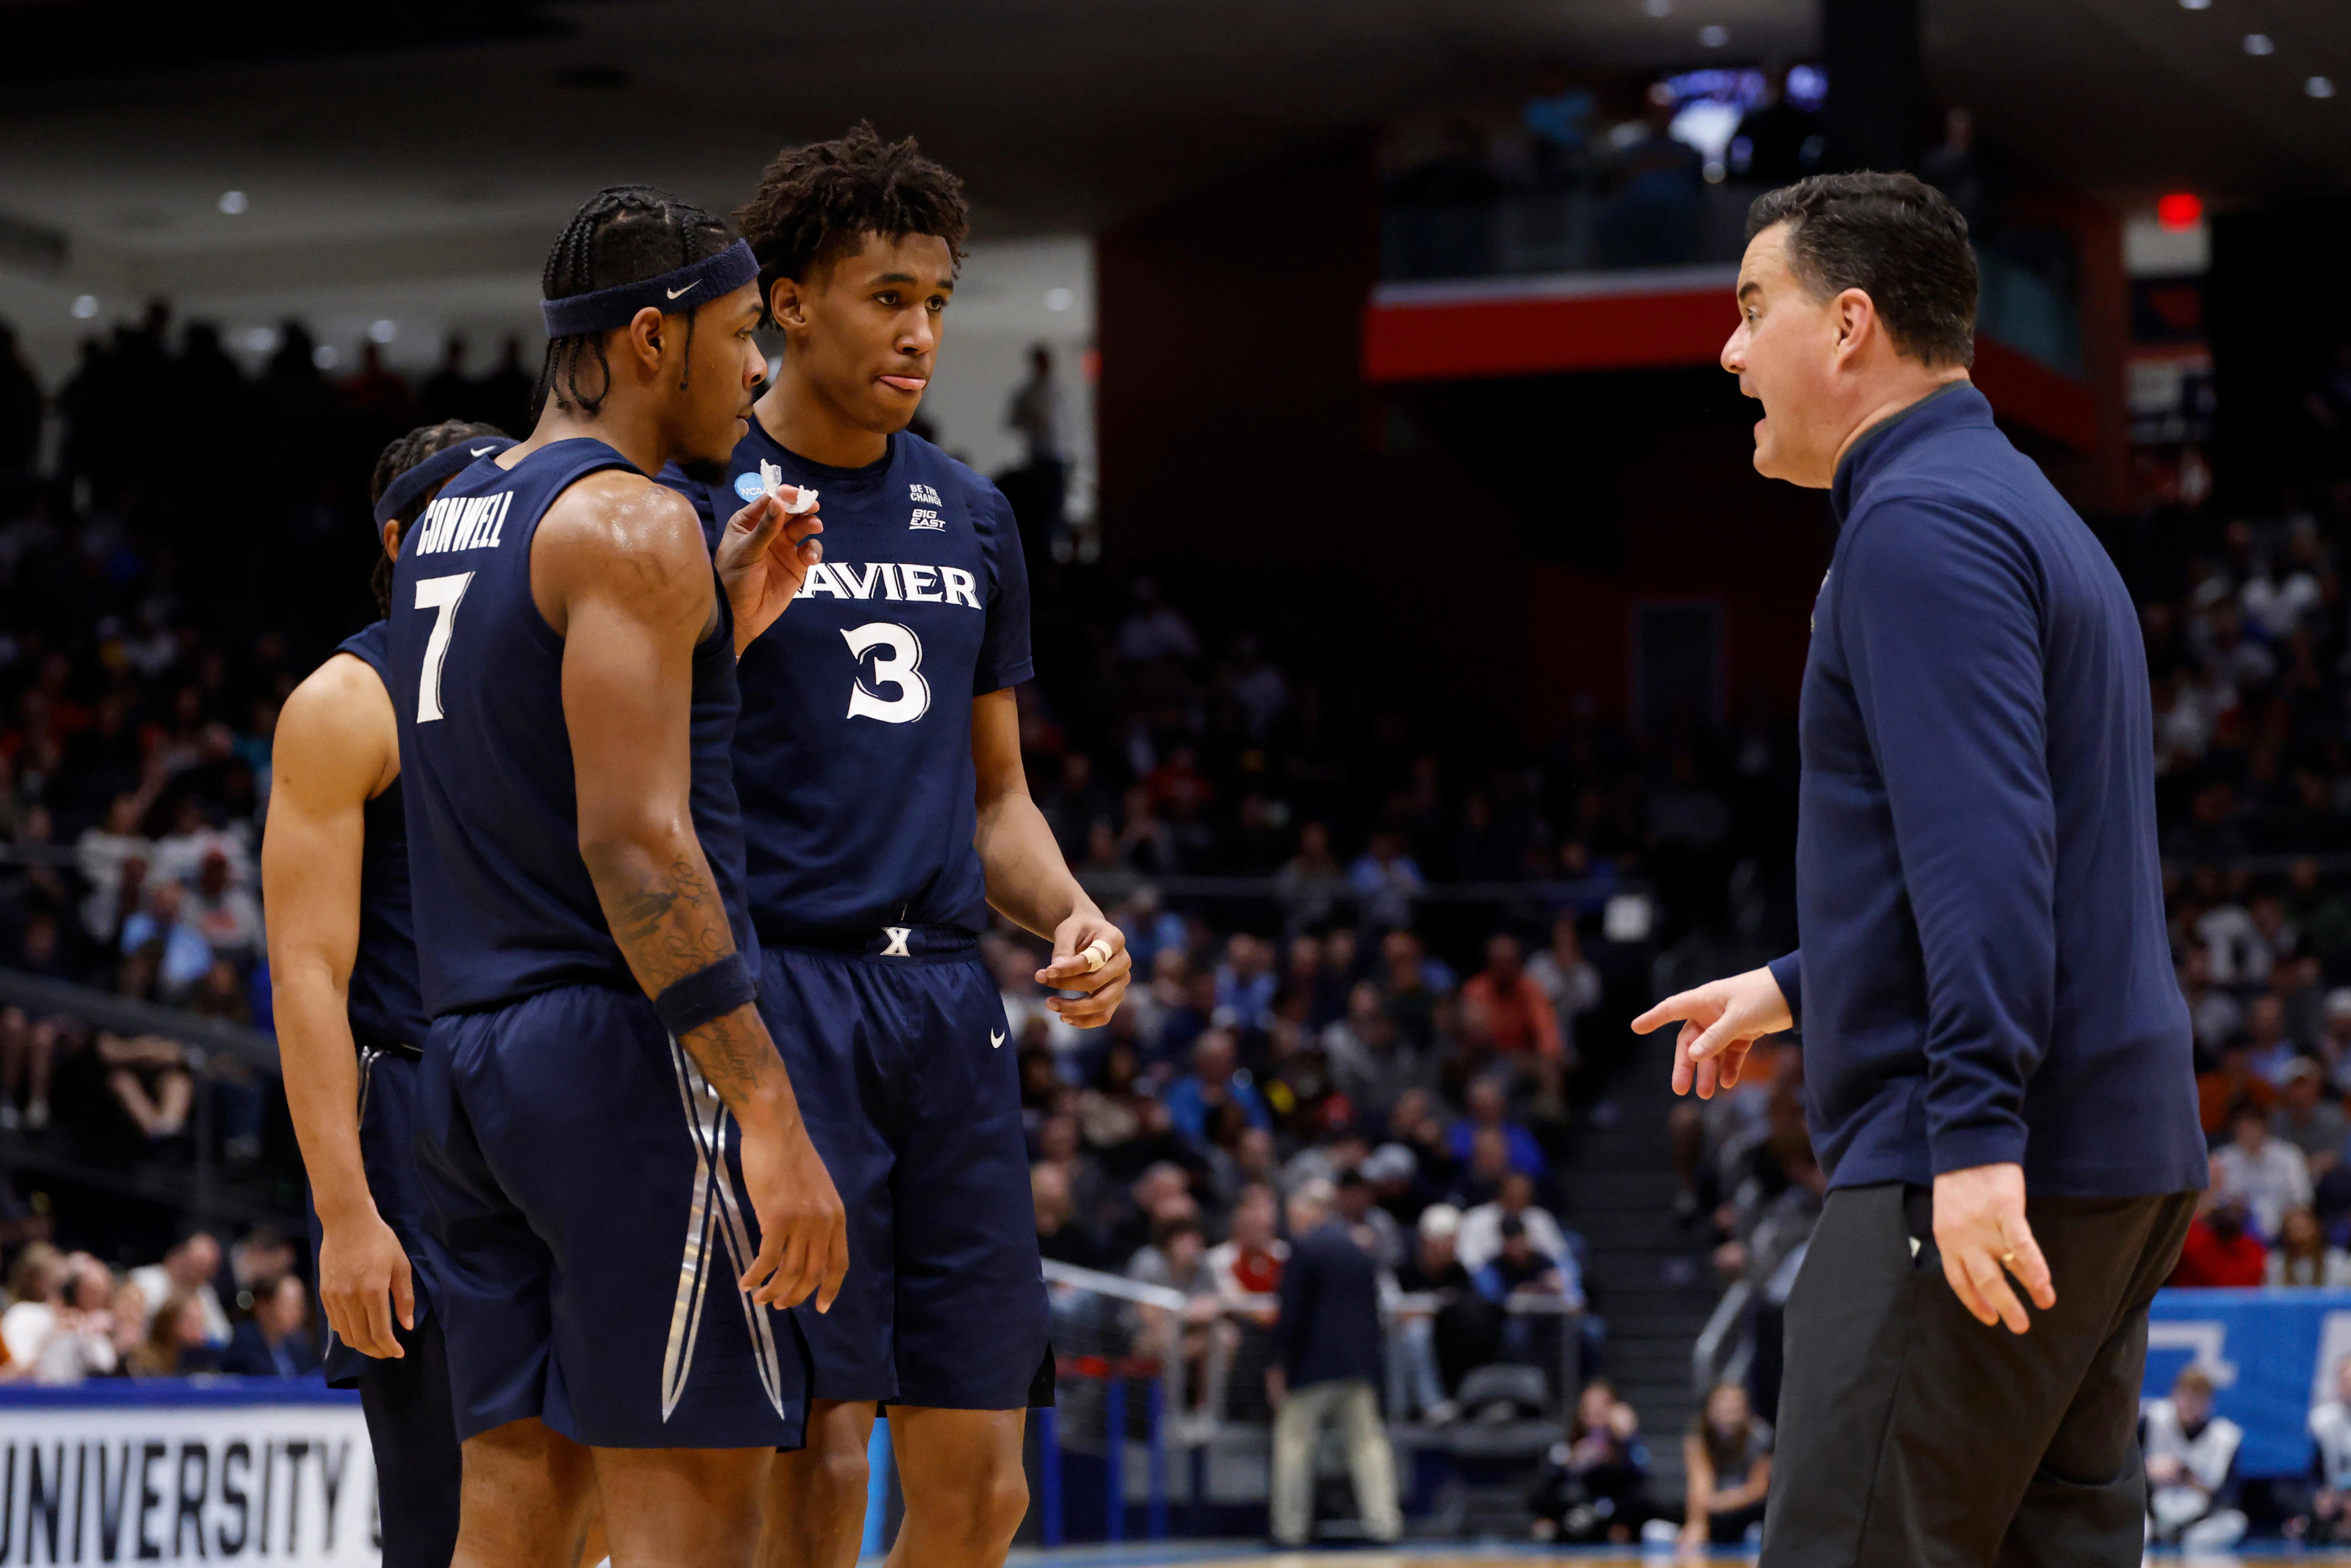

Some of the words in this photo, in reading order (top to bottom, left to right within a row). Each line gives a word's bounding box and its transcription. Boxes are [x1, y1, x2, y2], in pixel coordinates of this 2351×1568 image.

[909, 484, 923, 493] BE
[923, 485, 938, 498] THE
[910, 492, 942, 508] CHANGE
[416, 491, 514, 556] CONWELL
[909, 517, 946, 528] EAST
[912, 509, 937, 519] BIG
[793, 562, 982, 610] AVIER
[414, 571, 476, 723] 7
[840, 622, 931, 723] 3
[880, 927, 912, 956] X
